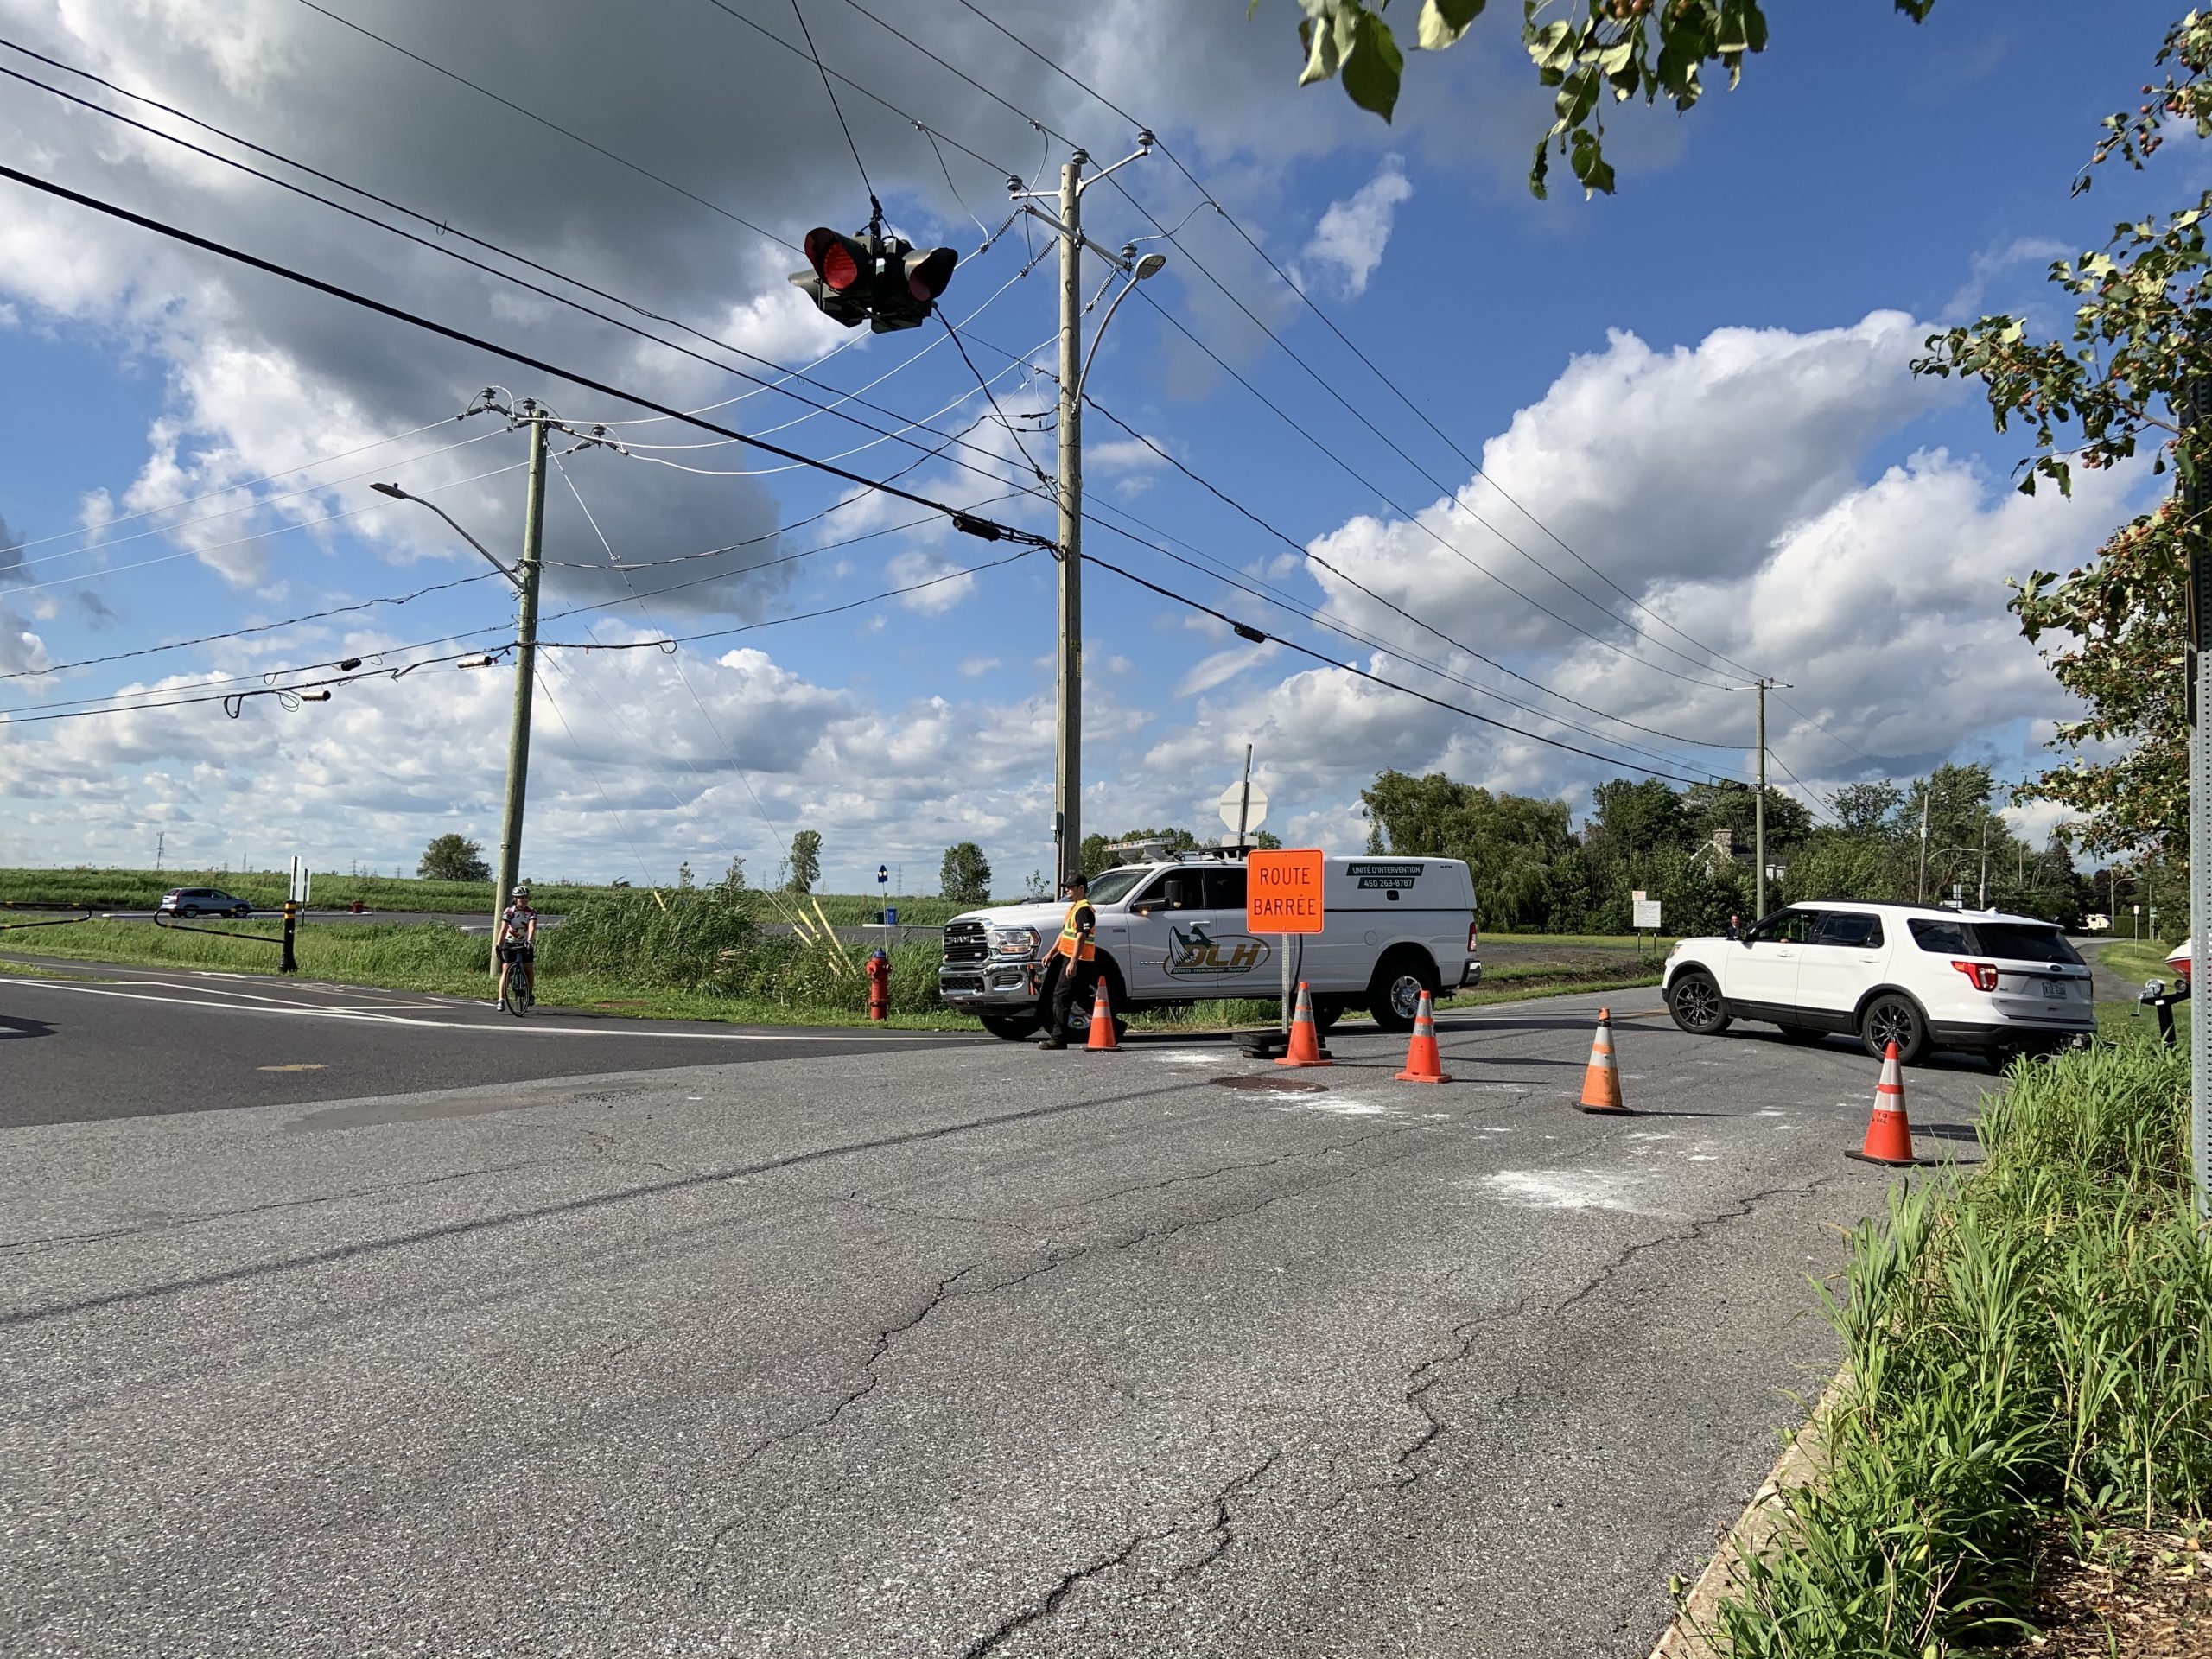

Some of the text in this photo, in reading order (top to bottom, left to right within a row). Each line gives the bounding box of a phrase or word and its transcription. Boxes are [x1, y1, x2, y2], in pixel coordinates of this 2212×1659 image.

[1260, 867, 1311, 886] ROUTE
[1352, 865, 1371, 874] UNITÉ
[1254, 893, 1316, 916] BARRÉE
